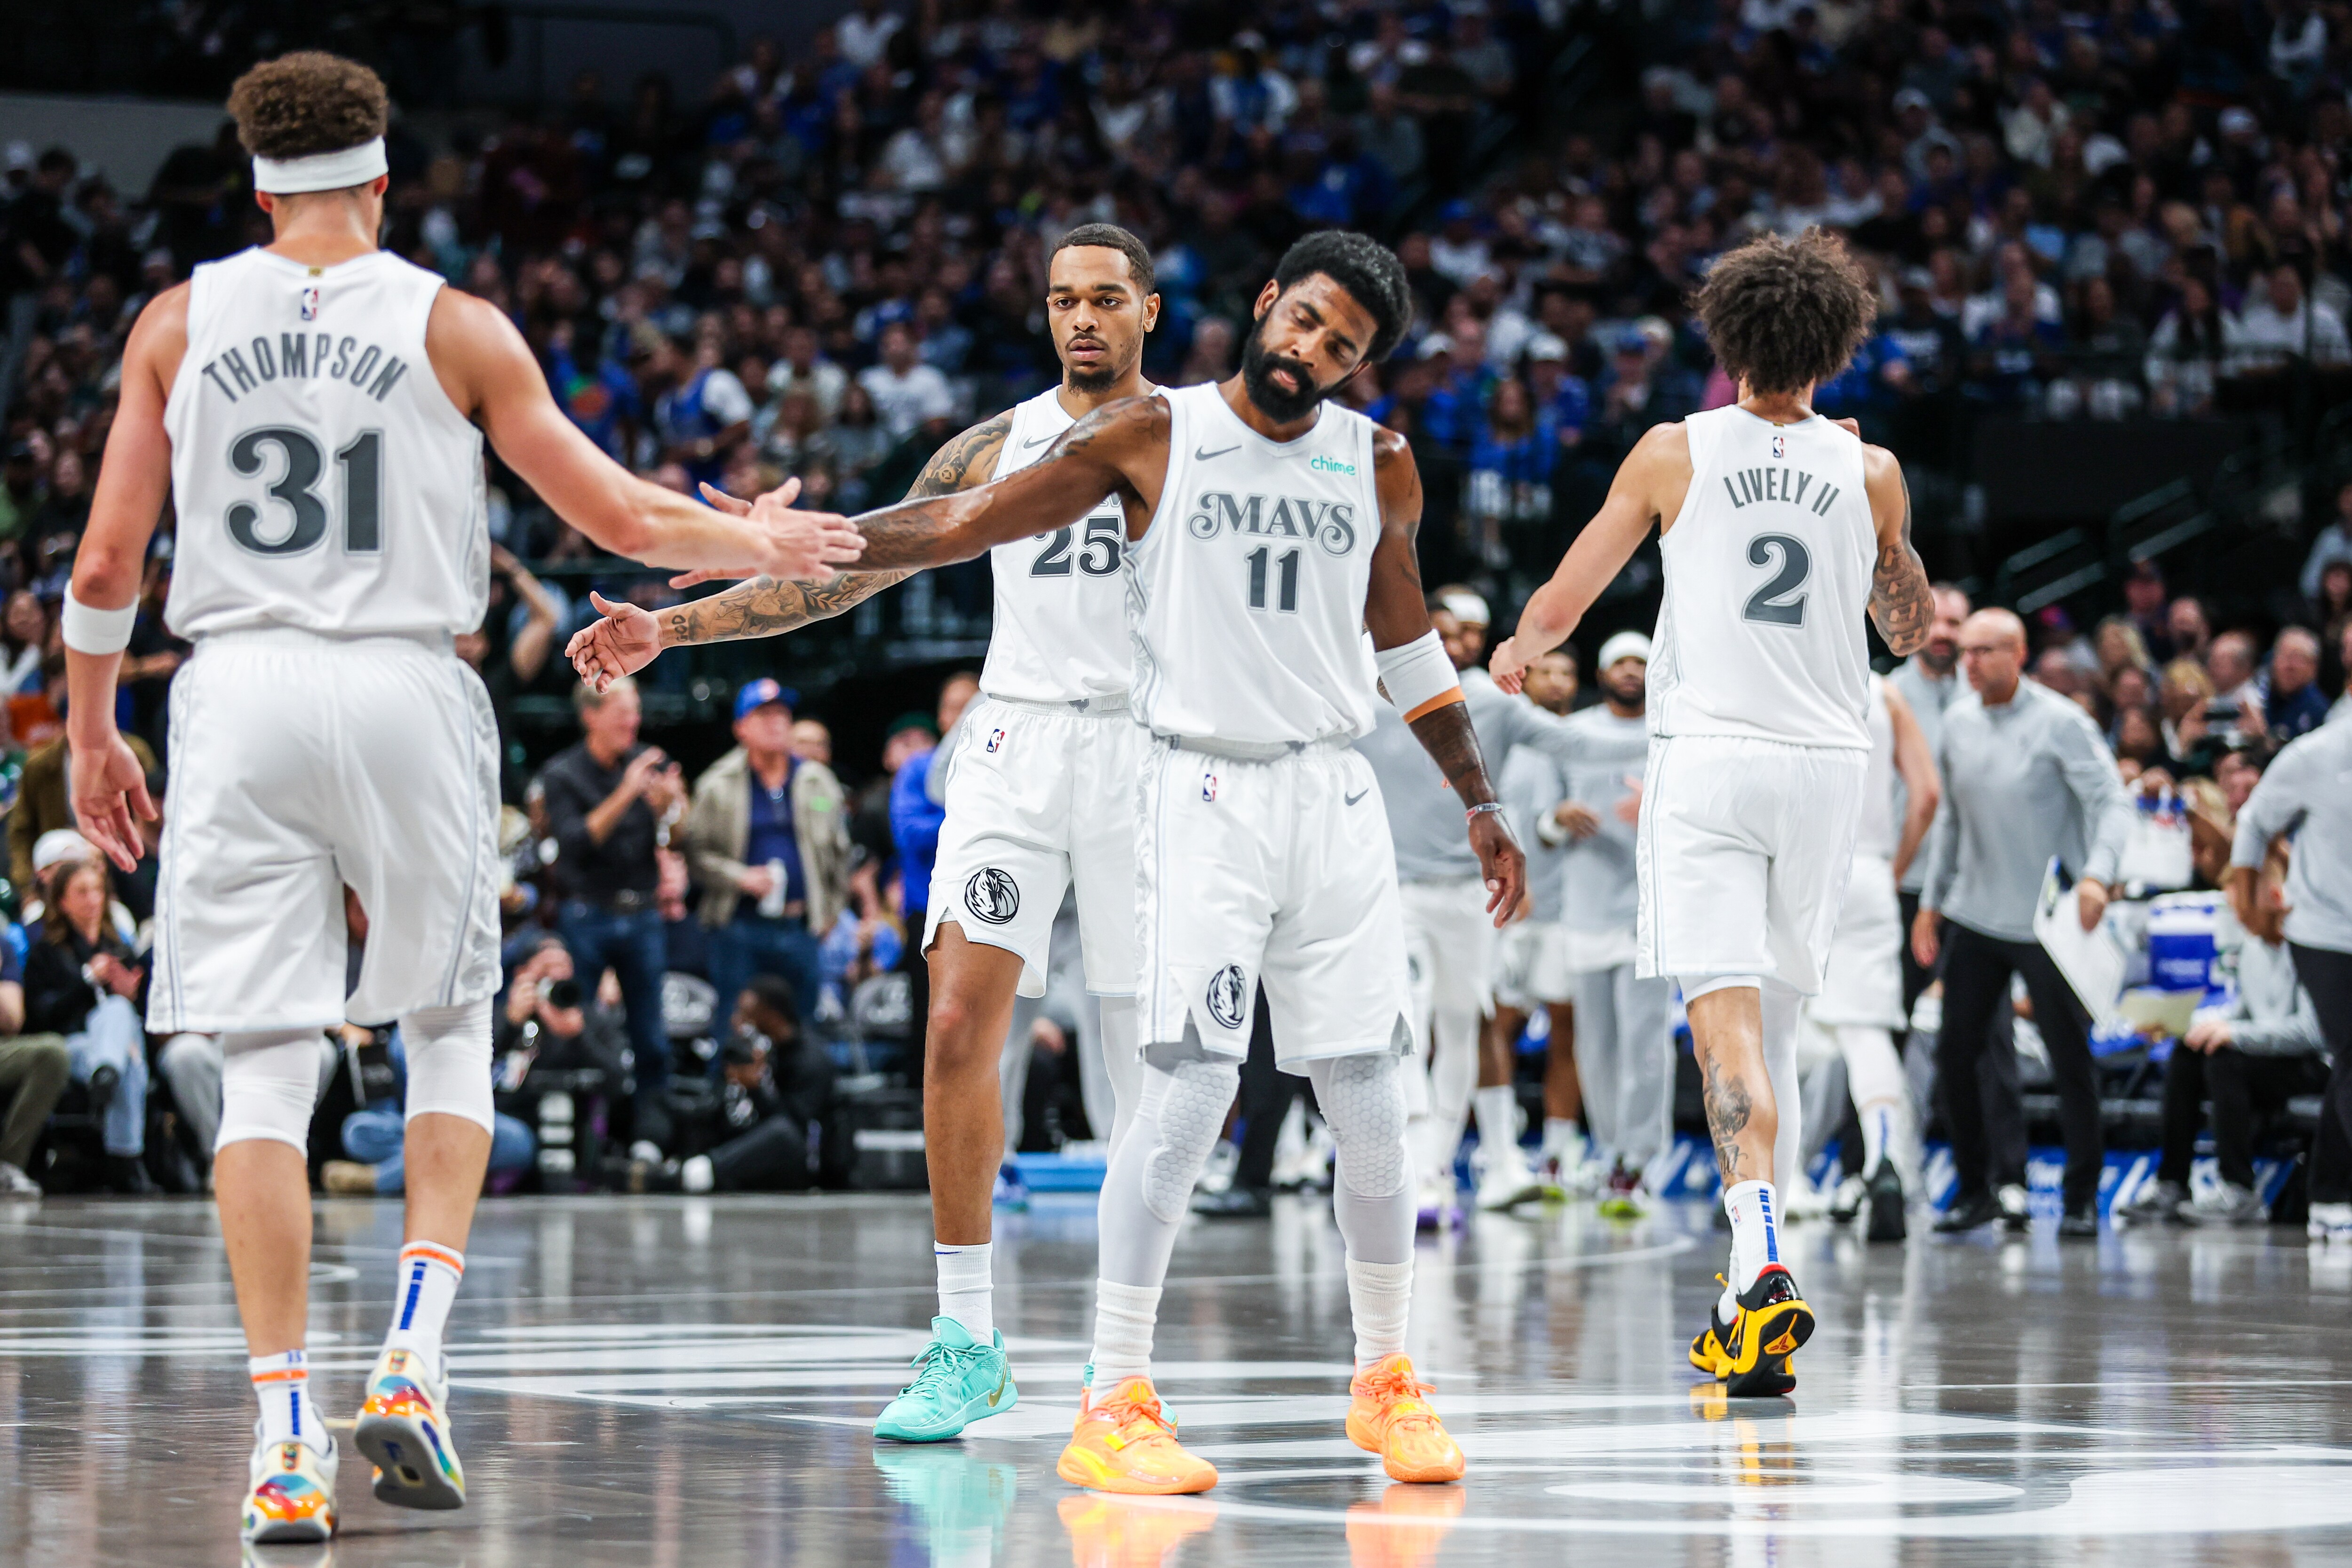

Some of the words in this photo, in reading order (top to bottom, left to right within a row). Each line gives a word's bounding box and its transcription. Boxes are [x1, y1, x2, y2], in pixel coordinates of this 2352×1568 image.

[202, 333, 408, 403] THOMPSON
[224, 424, 385, 558] 31
[1311, 455, 1355, 475] chime
[1723, 467, 1812, 509] LIVELY
[1812, 483, 1840, 517] II
[1029, 516, 1122, 578] 25
[1187, 490, 1357, 557] MAVS
[1244, 544, 1302, 614] 11
[1741, 532, 1812, 629] 2
